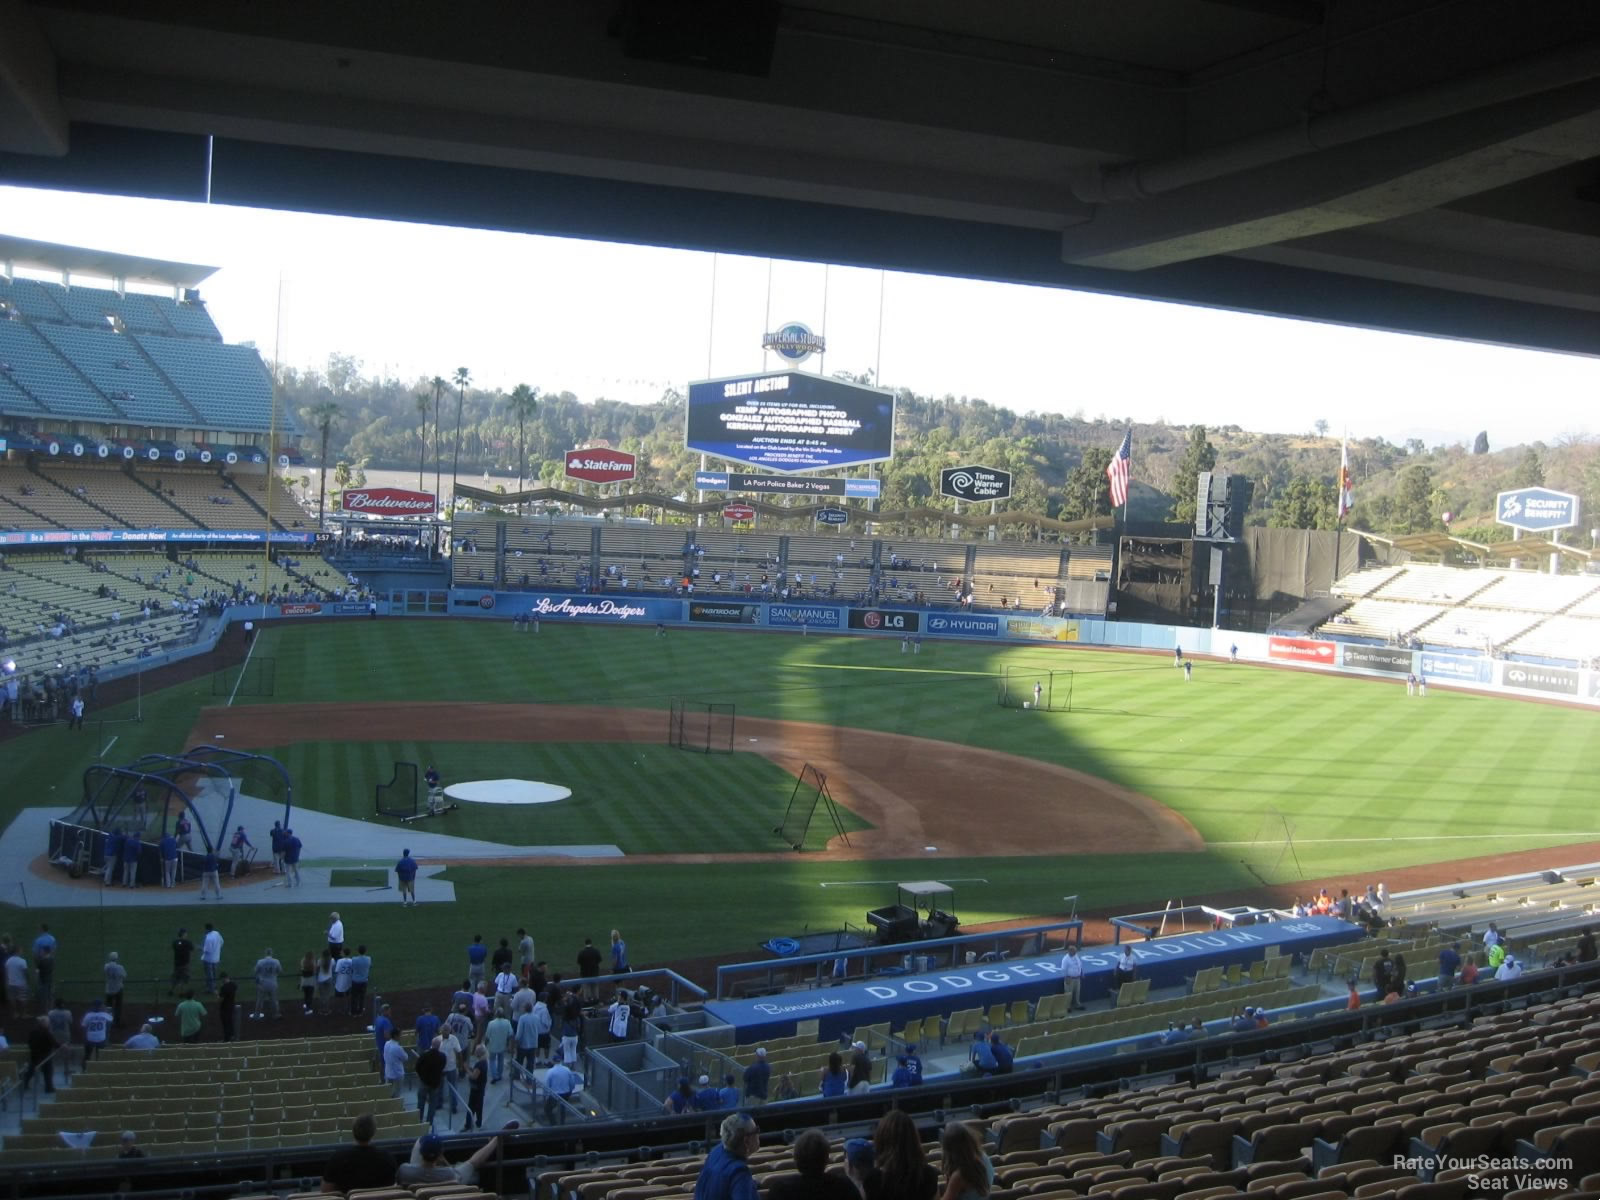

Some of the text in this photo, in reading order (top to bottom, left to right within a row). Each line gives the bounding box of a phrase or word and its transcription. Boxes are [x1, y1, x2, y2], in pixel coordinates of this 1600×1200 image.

[762, 331, 799, 345] UNIVERSAL
[724, 376, 789, 397] SILENT AUCTION
[735, 406, 847, 419] KEMP AUTOGRAPHED PHOTO
[720, 413, 861, 428] GONZALEZ AUTOGRAPHED BASEBALL
[726, 422, 855, 435] KERSHAW AUTOGRAPHED JERSEY
[975, 472, 995, 480] Time
[766, 480, 786, 488] Police
[787, 481, 804, 489] Baker
[811, 482, 830, 491] Vegas
[974, 480, 1003, 488] Warner
[974, 487, 997, 495] Cable
[346, 493, 433, 509] Budweiser
[1526, 498, 1569, 509] SECURITY
[79, 531, 90, 541] the
[122, 532, 167, 540] Donate Now!
[532, 597, 646, 619] Los Angeles Dodgers
[701, 607, 741, 616] HANKOOK
[771, 608, 838, 619] SAN MANUEL
[884, 615, 905, 628] LG
[950, 620, 997, 631] HYUNDAI
[1353, 653, 1410, 666] Time Warner Cable
[1527, 673, 1573, 686] INFINITI
[864, 931, 1263, 999] DODGER STADIUM
[753, 998, 845, 1015] Bienvenidos
[620, 1012, 626, 1021] 5
[89, 1021, 103, 1032] 20
